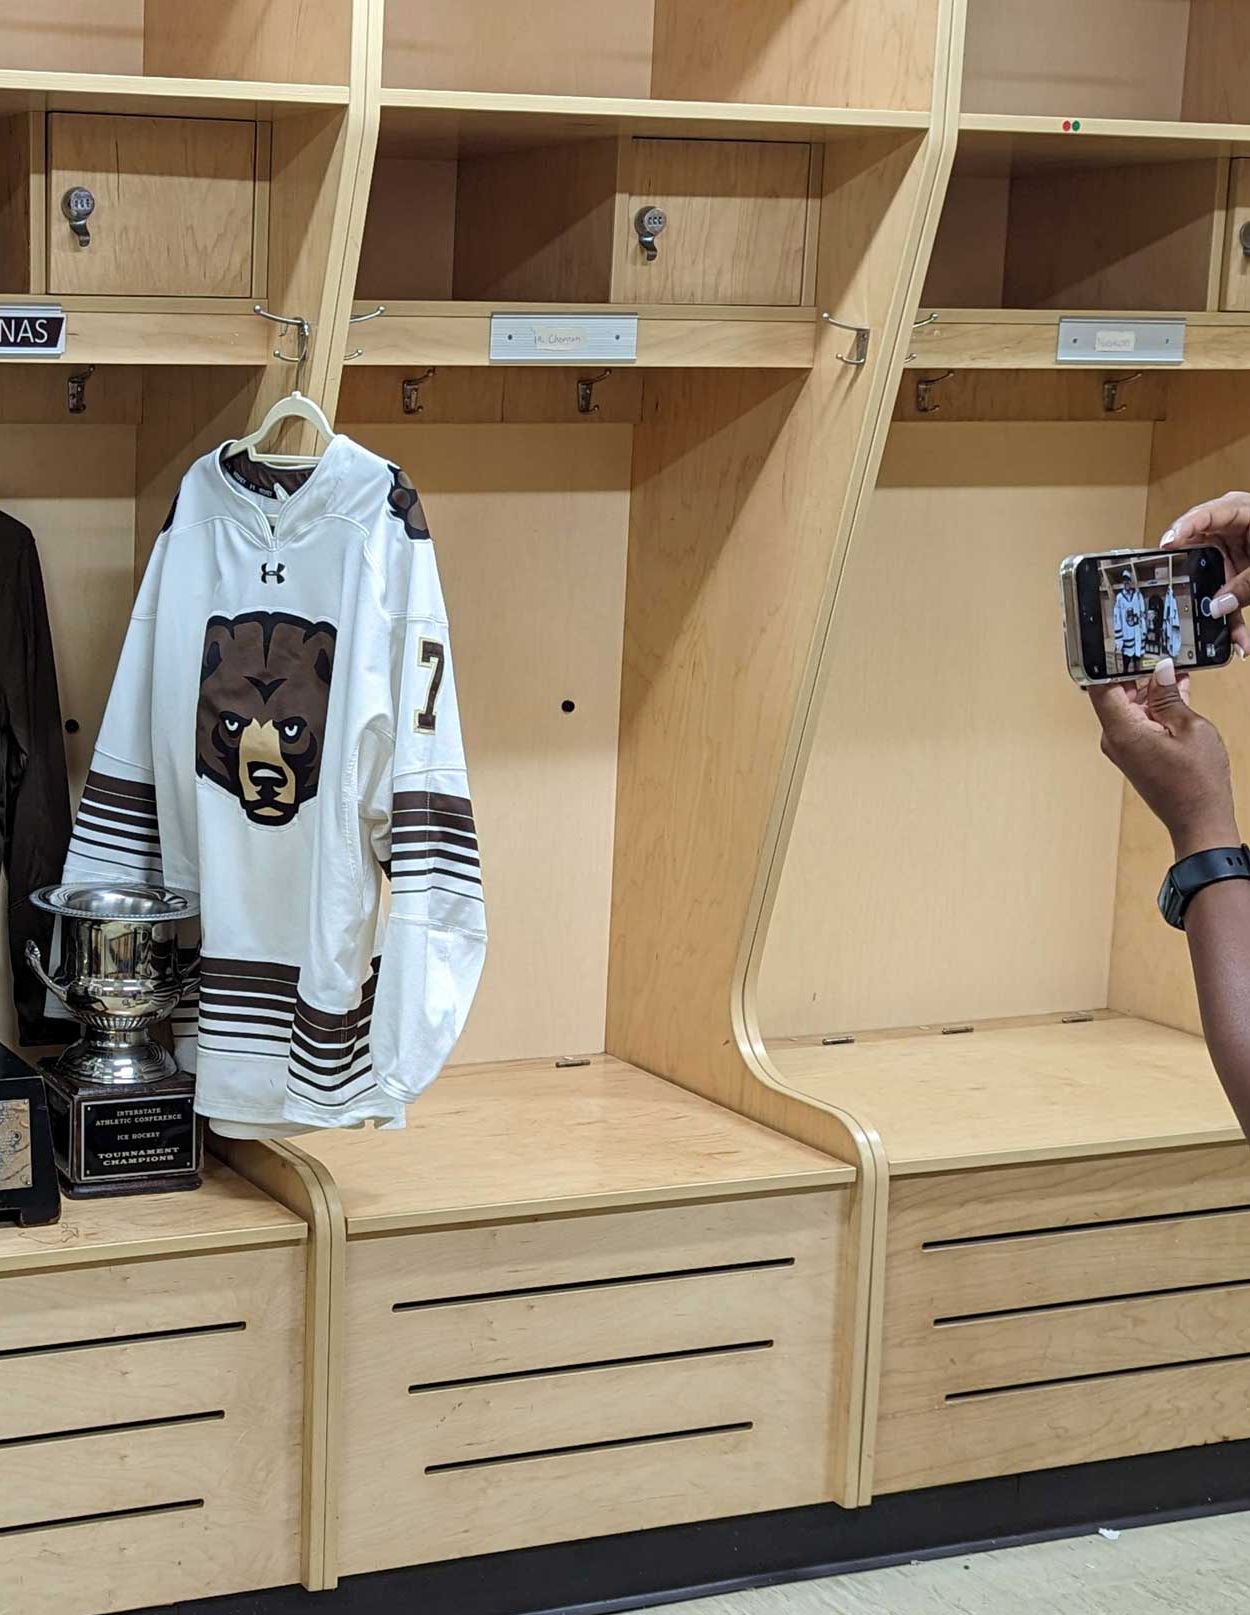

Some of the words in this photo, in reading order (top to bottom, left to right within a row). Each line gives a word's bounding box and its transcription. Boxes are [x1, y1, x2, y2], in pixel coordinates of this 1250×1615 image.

[413, 636, 446, 736] 7
[116, 1107, 161, 1117] INTERSTATE
[95, 1117, 132, 1127] ATHLETIC
[134, 1113, 182, 1123] CONFERENCE
[131, 1131, 160, 1140] HOCKEY
[97, 1147, 180, 1159] TOURNAMENT
[102, 1155, 174, 1166] CHAMPIONS
